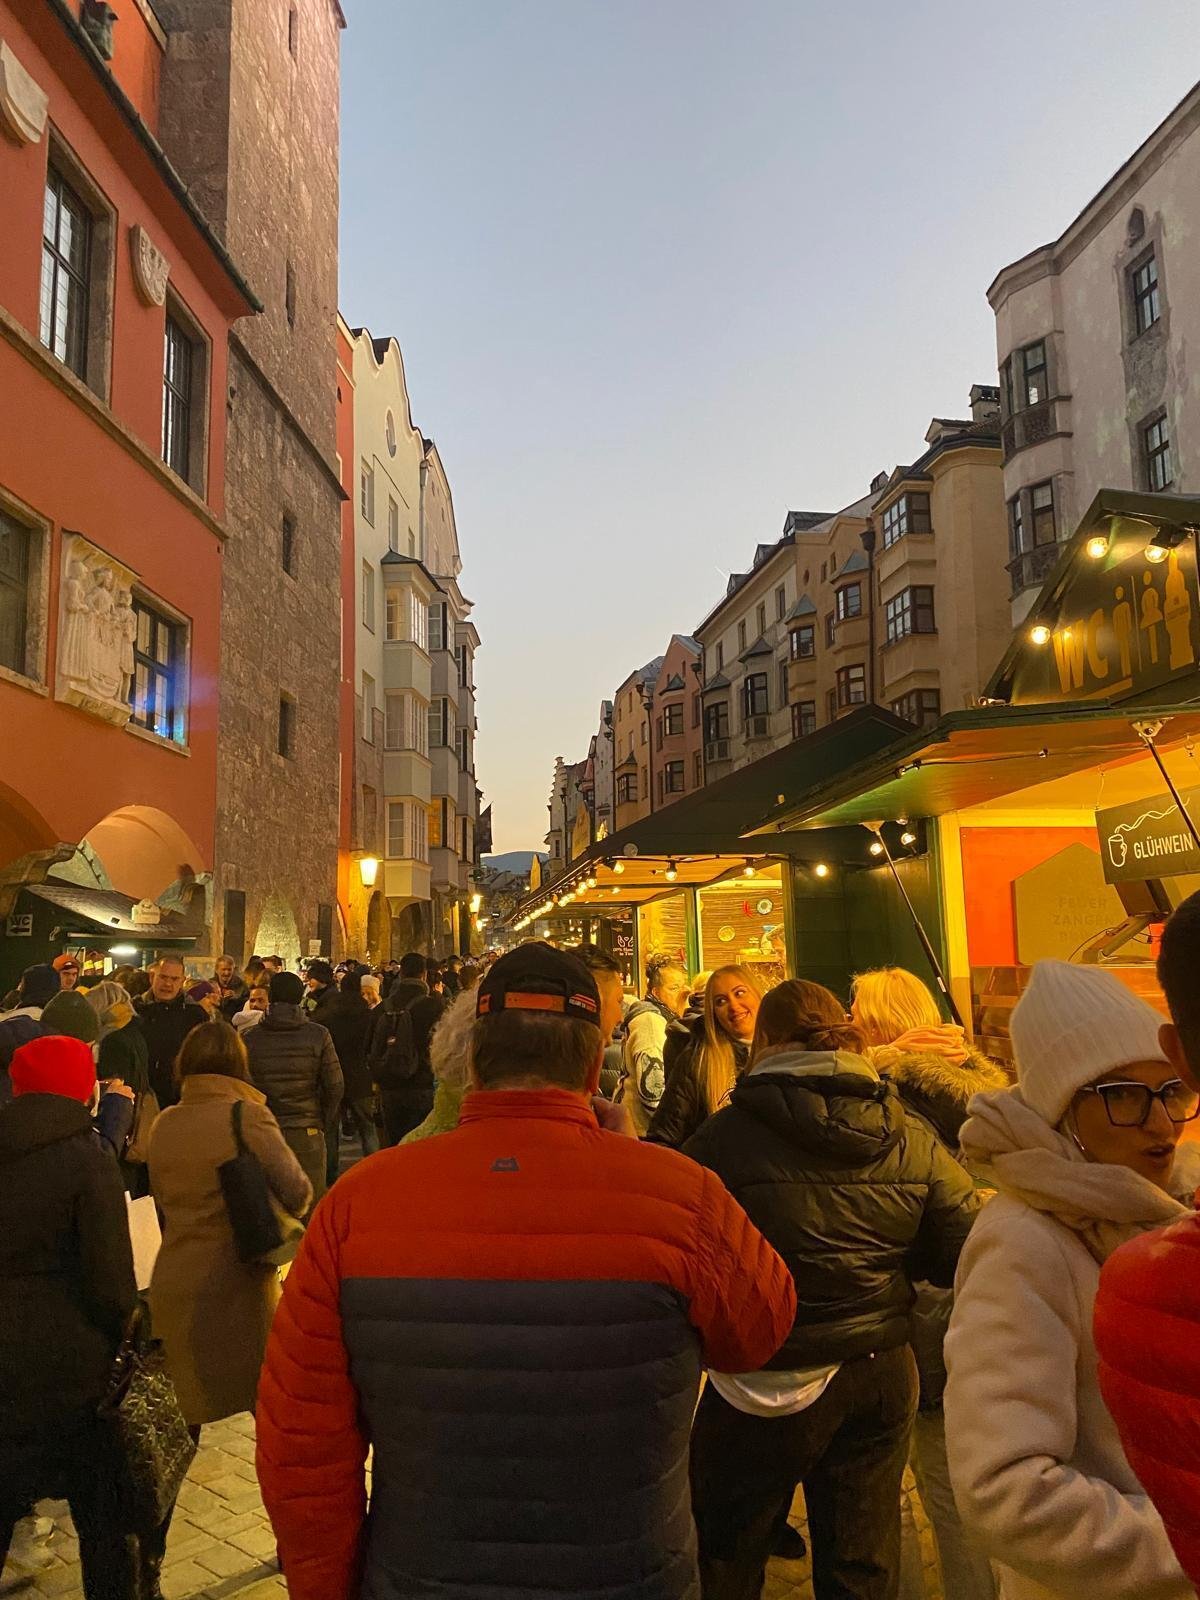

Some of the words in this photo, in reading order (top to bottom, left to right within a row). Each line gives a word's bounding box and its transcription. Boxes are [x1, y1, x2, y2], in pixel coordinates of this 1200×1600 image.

[1052, 608, 1108, 694] WC
[1133, 833, 1194, 859] GLÜHWEIN
[10, 916, 31, 927] WC
